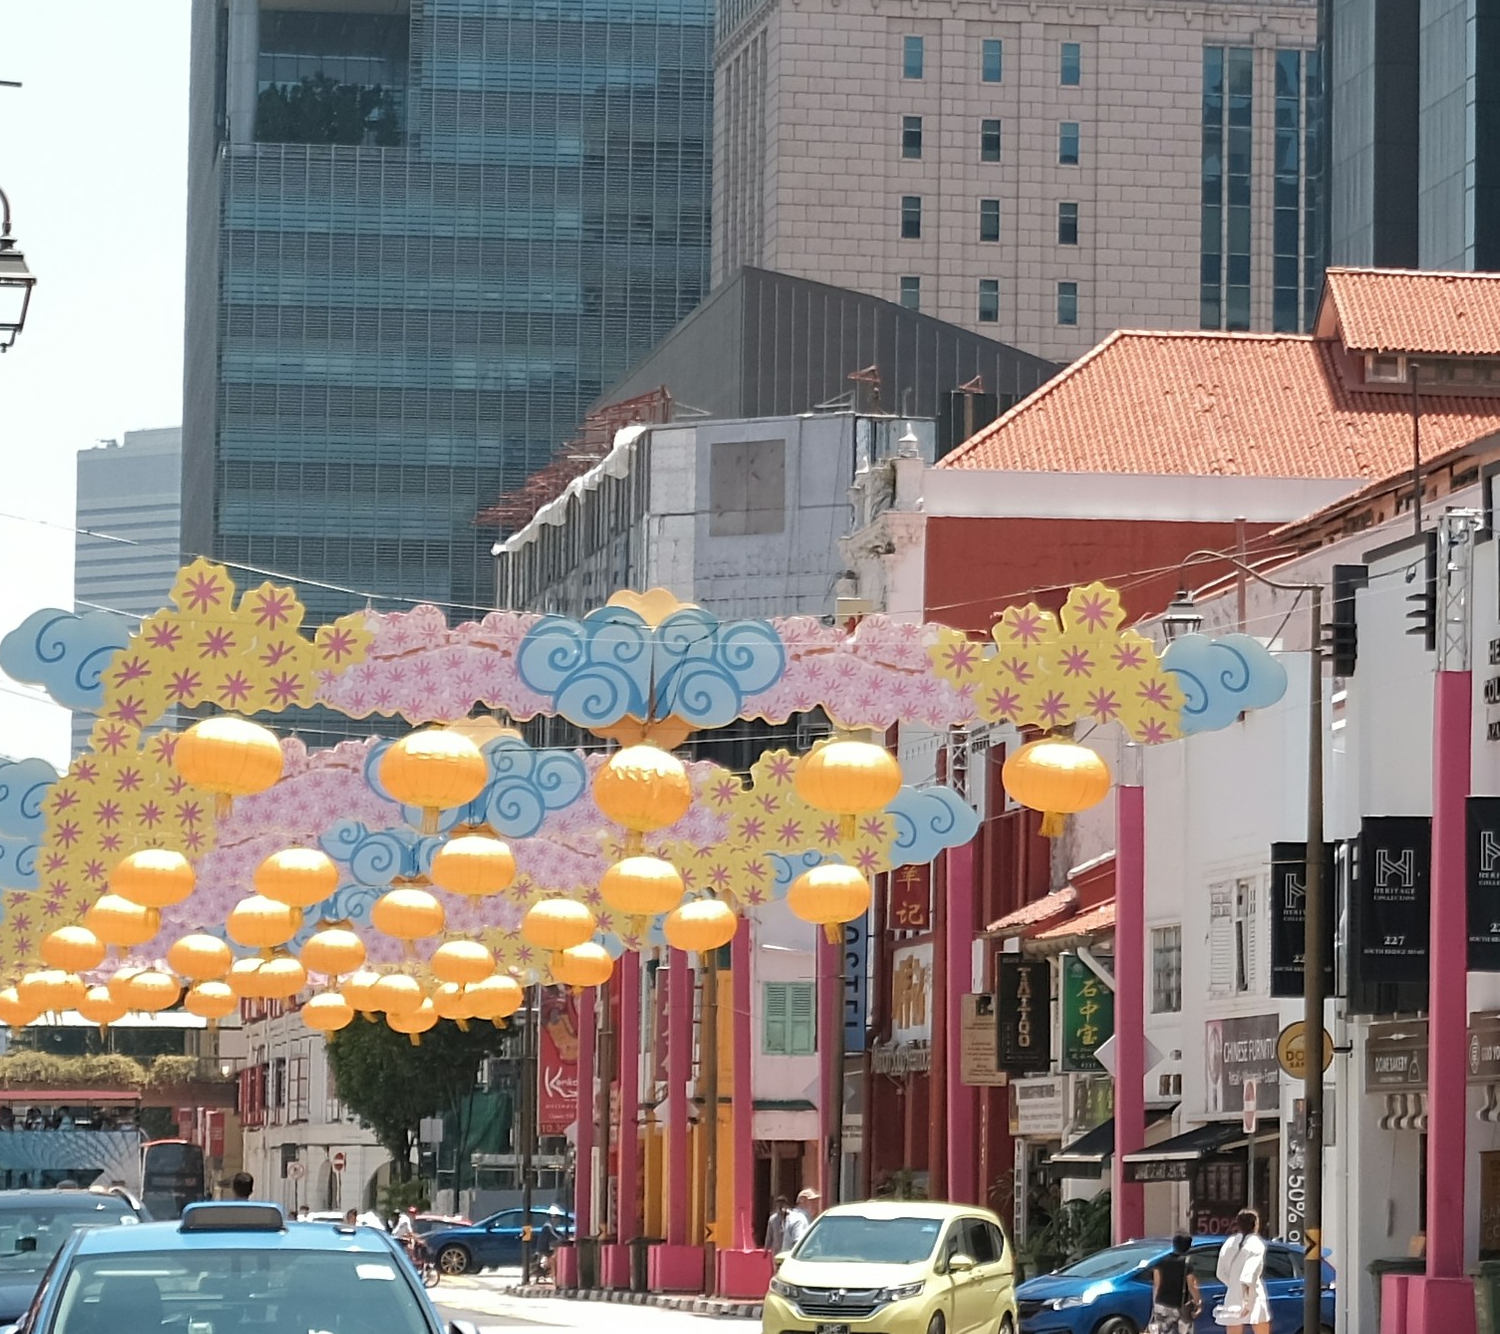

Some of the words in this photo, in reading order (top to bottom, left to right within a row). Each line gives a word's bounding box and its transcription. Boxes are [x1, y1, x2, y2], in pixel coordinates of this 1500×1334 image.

[1373, 887, 1416, 895] HERITAGE
[1383, 935, 1406, 946] 227
[1292, 954, 1306, 963] 22
[1016, 967, 1032, 1047] TATTOO
[1076, 979, 1099, 1046] 石中宝
[1223, 1040, 1248, 1063] CHINESE
[1286, 1050, 1304, 1062] DO
